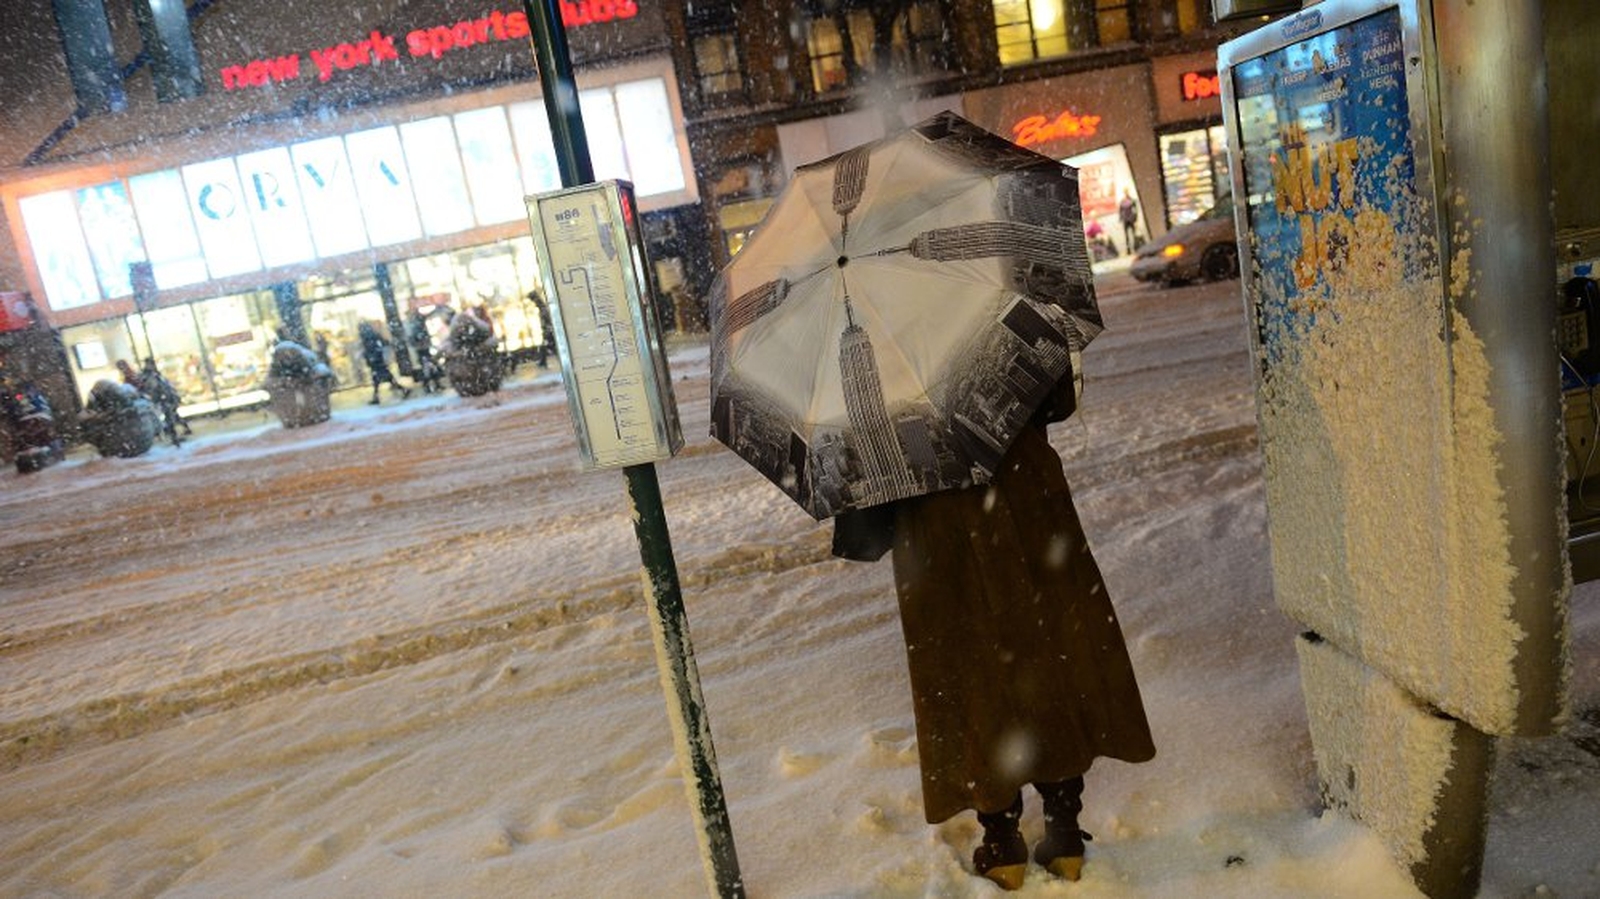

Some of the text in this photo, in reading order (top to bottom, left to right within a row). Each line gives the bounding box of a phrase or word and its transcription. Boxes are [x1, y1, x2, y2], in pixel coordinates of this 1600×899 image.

[220, 0, 638, 90] new york sports lubs
[199, 159, 399, 219] ORVA
[1270, 137, 1358, 215] NUT
